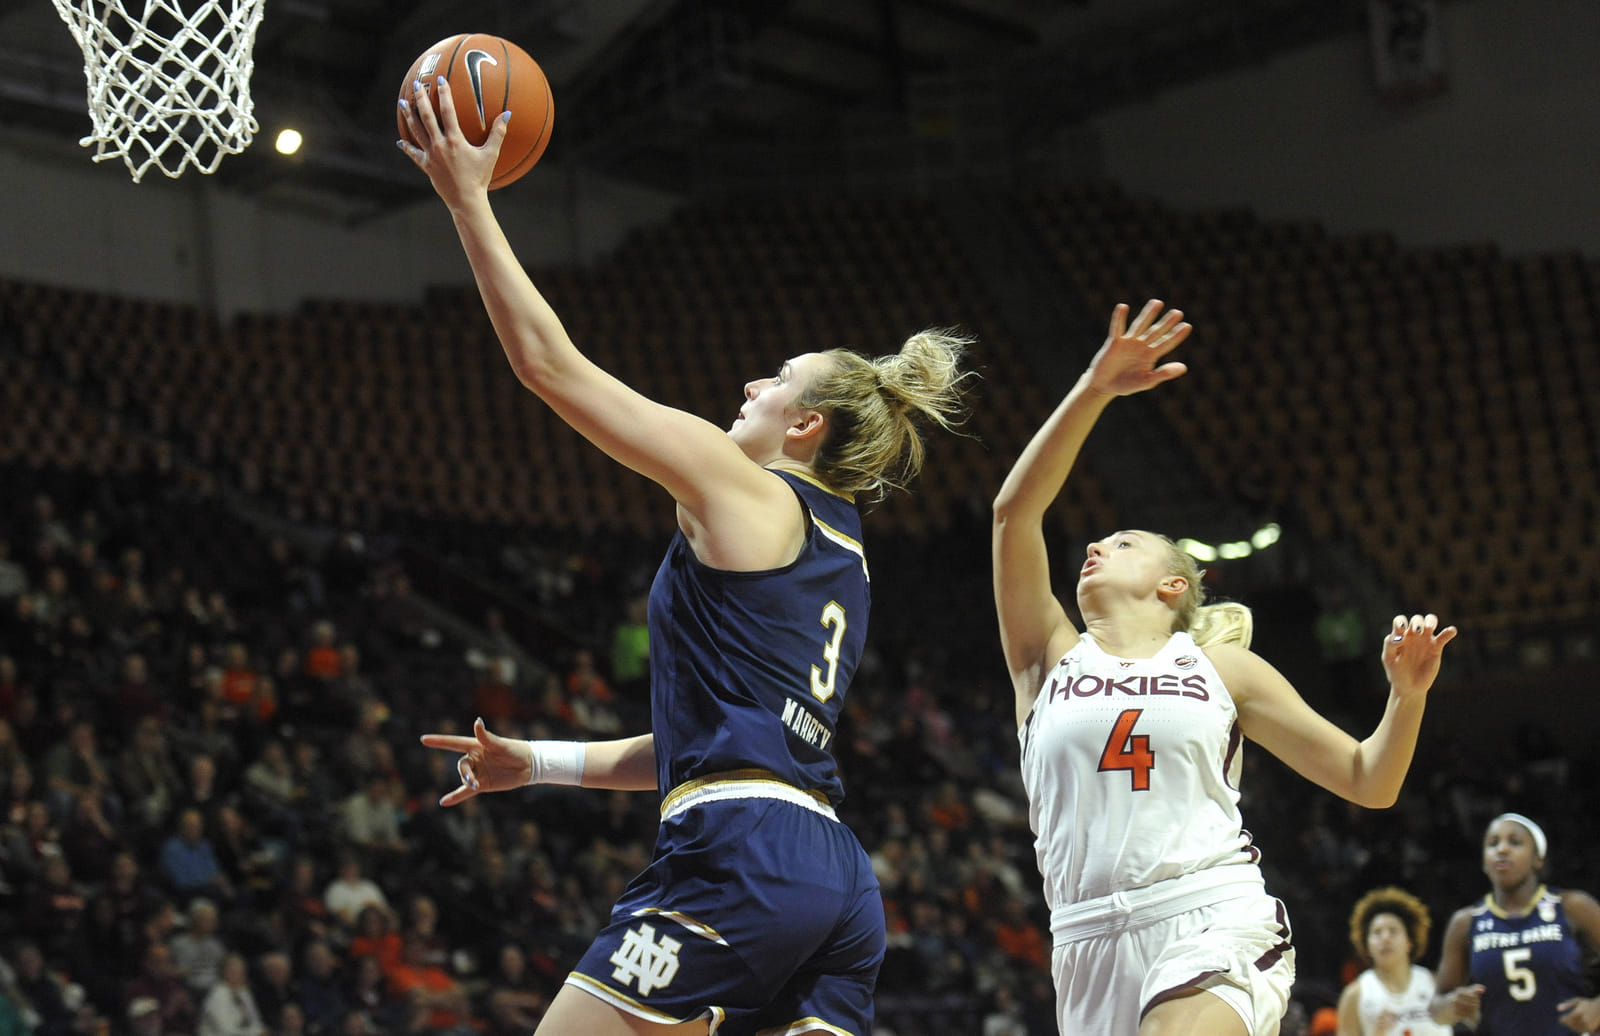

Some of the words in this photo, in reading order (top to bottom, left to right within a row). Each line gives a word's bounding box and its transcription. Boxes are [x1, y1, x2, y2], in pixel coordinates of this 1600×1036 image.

[810, 600, 847, 704] 3
[1049, 674, 1209, 704] HOKIES
[1097, 709, 1155, 791] 4
[1503, 948, 1537, 1001] 5
